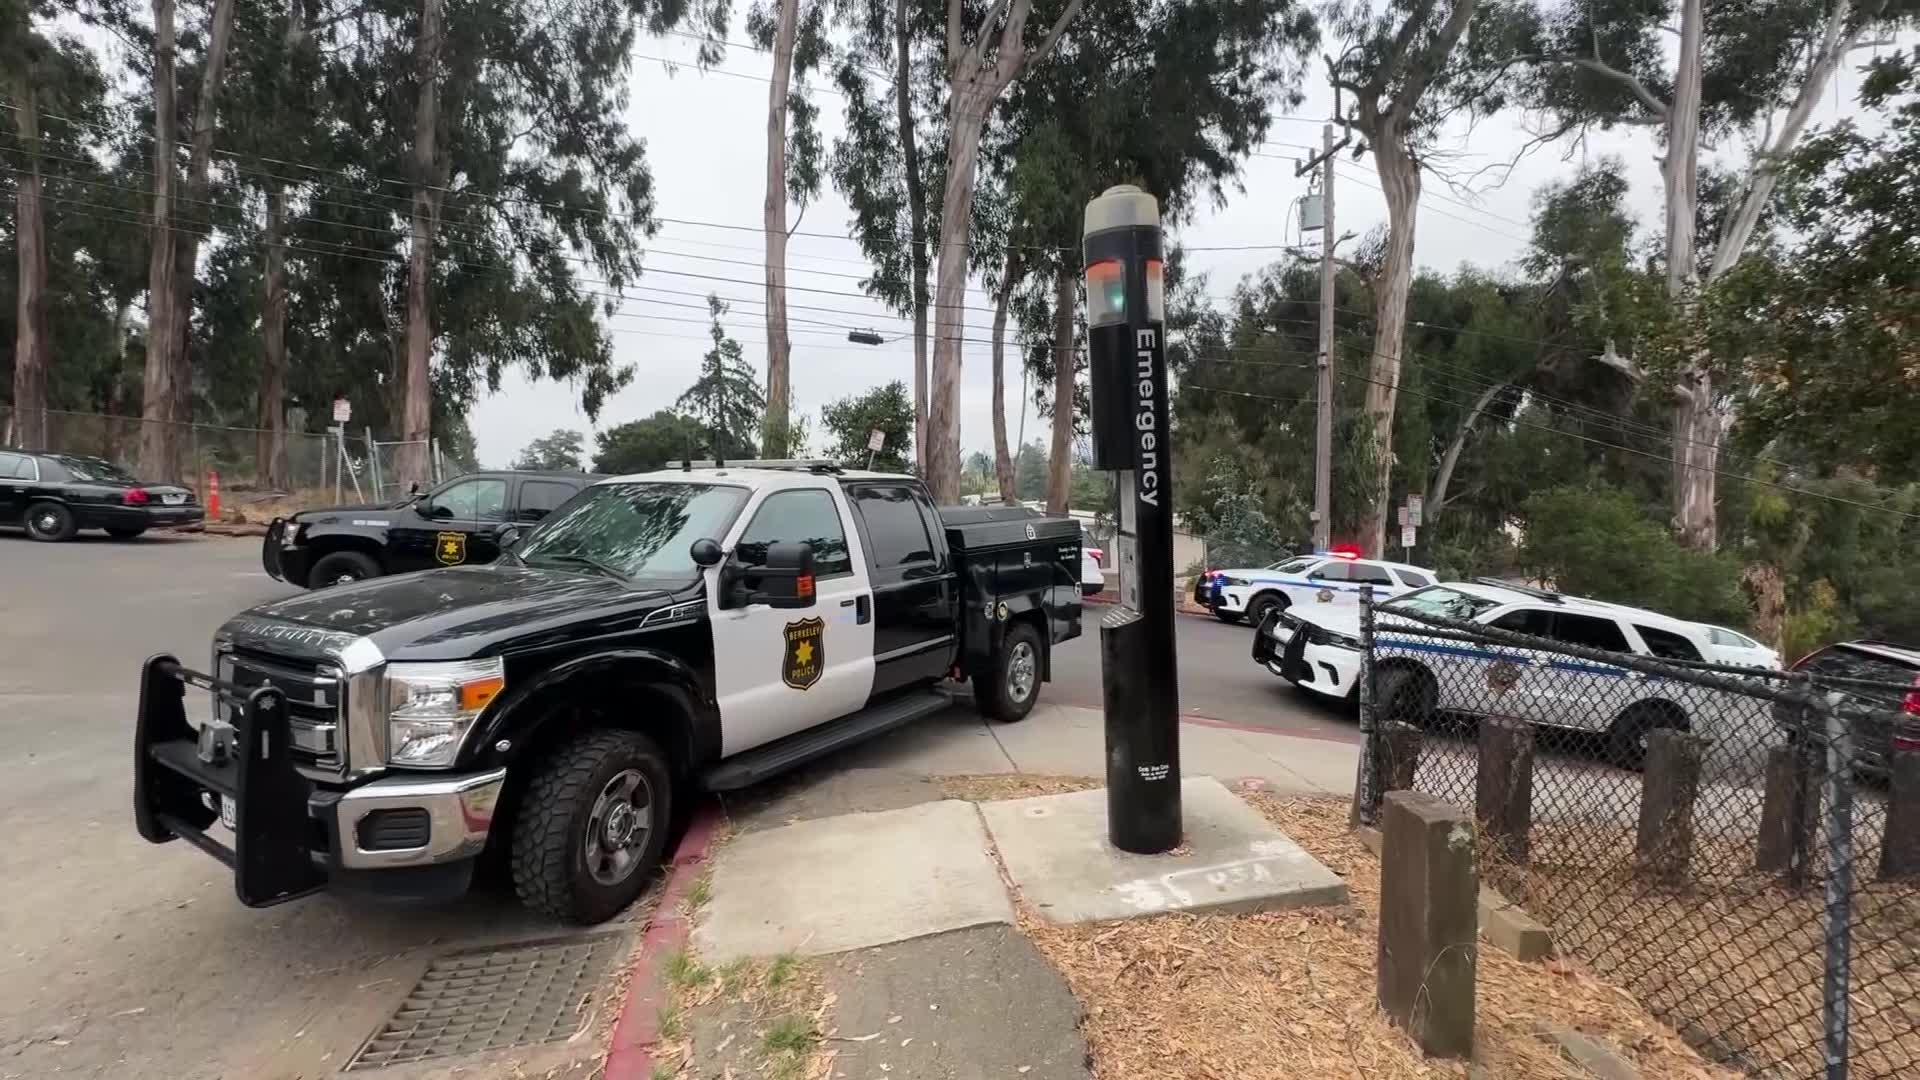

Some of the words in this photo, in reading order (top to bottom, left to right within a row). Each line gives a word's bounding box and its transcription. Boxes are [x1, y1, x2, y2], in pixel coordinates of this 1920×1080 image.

[1136, 329, 1158, 506] Emergency
[789, 626, 820, 641] BERKELEY
[791, 664, 816, 679] POLICE
